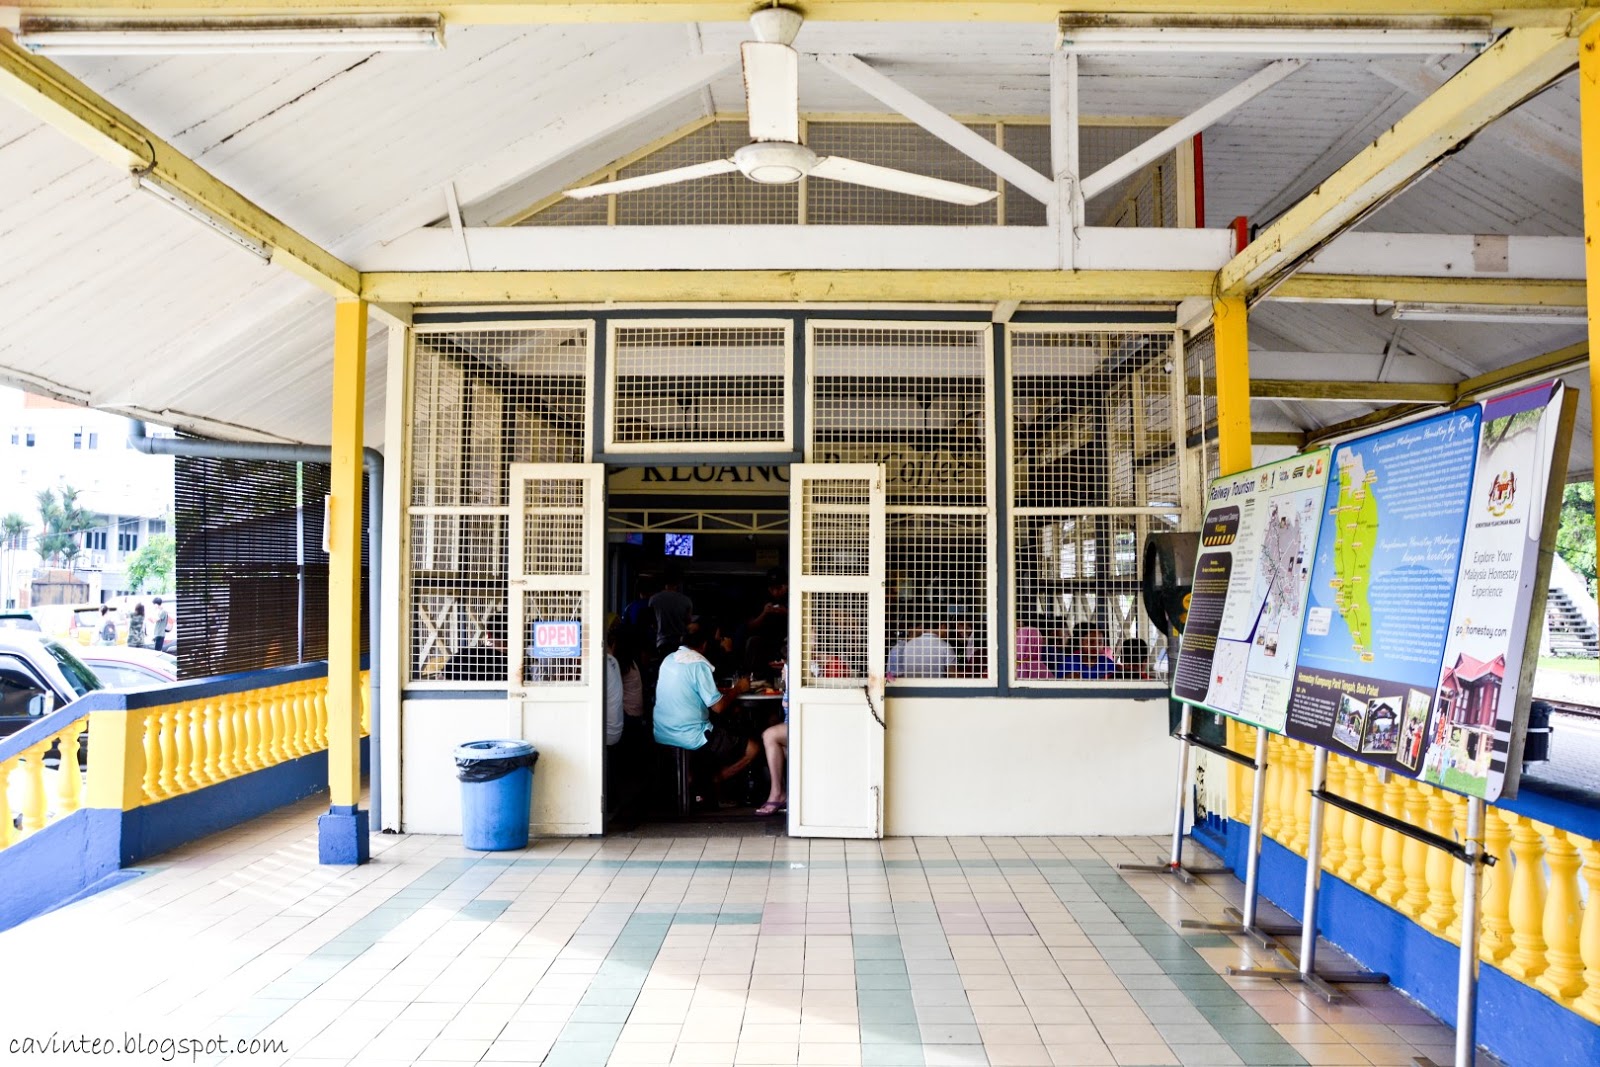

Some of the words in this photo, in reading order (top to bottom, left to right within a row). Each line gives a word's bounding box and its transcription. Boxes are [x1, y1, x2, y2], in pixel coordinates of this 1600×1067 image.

[1209, 485, 1231, 501] Railway
[1231, 480, 1256, 496] Tourism
[1473, 551, 1495, 565] Explore
[1497, 550, 1512, 562] Your
[1464, 568, 1487, 583] Malaysia
[1487, 568, 1519, 581] Homestay
[1472, 585, 1503, 598] Experience
[537, 626, 576, 646] OPEN
